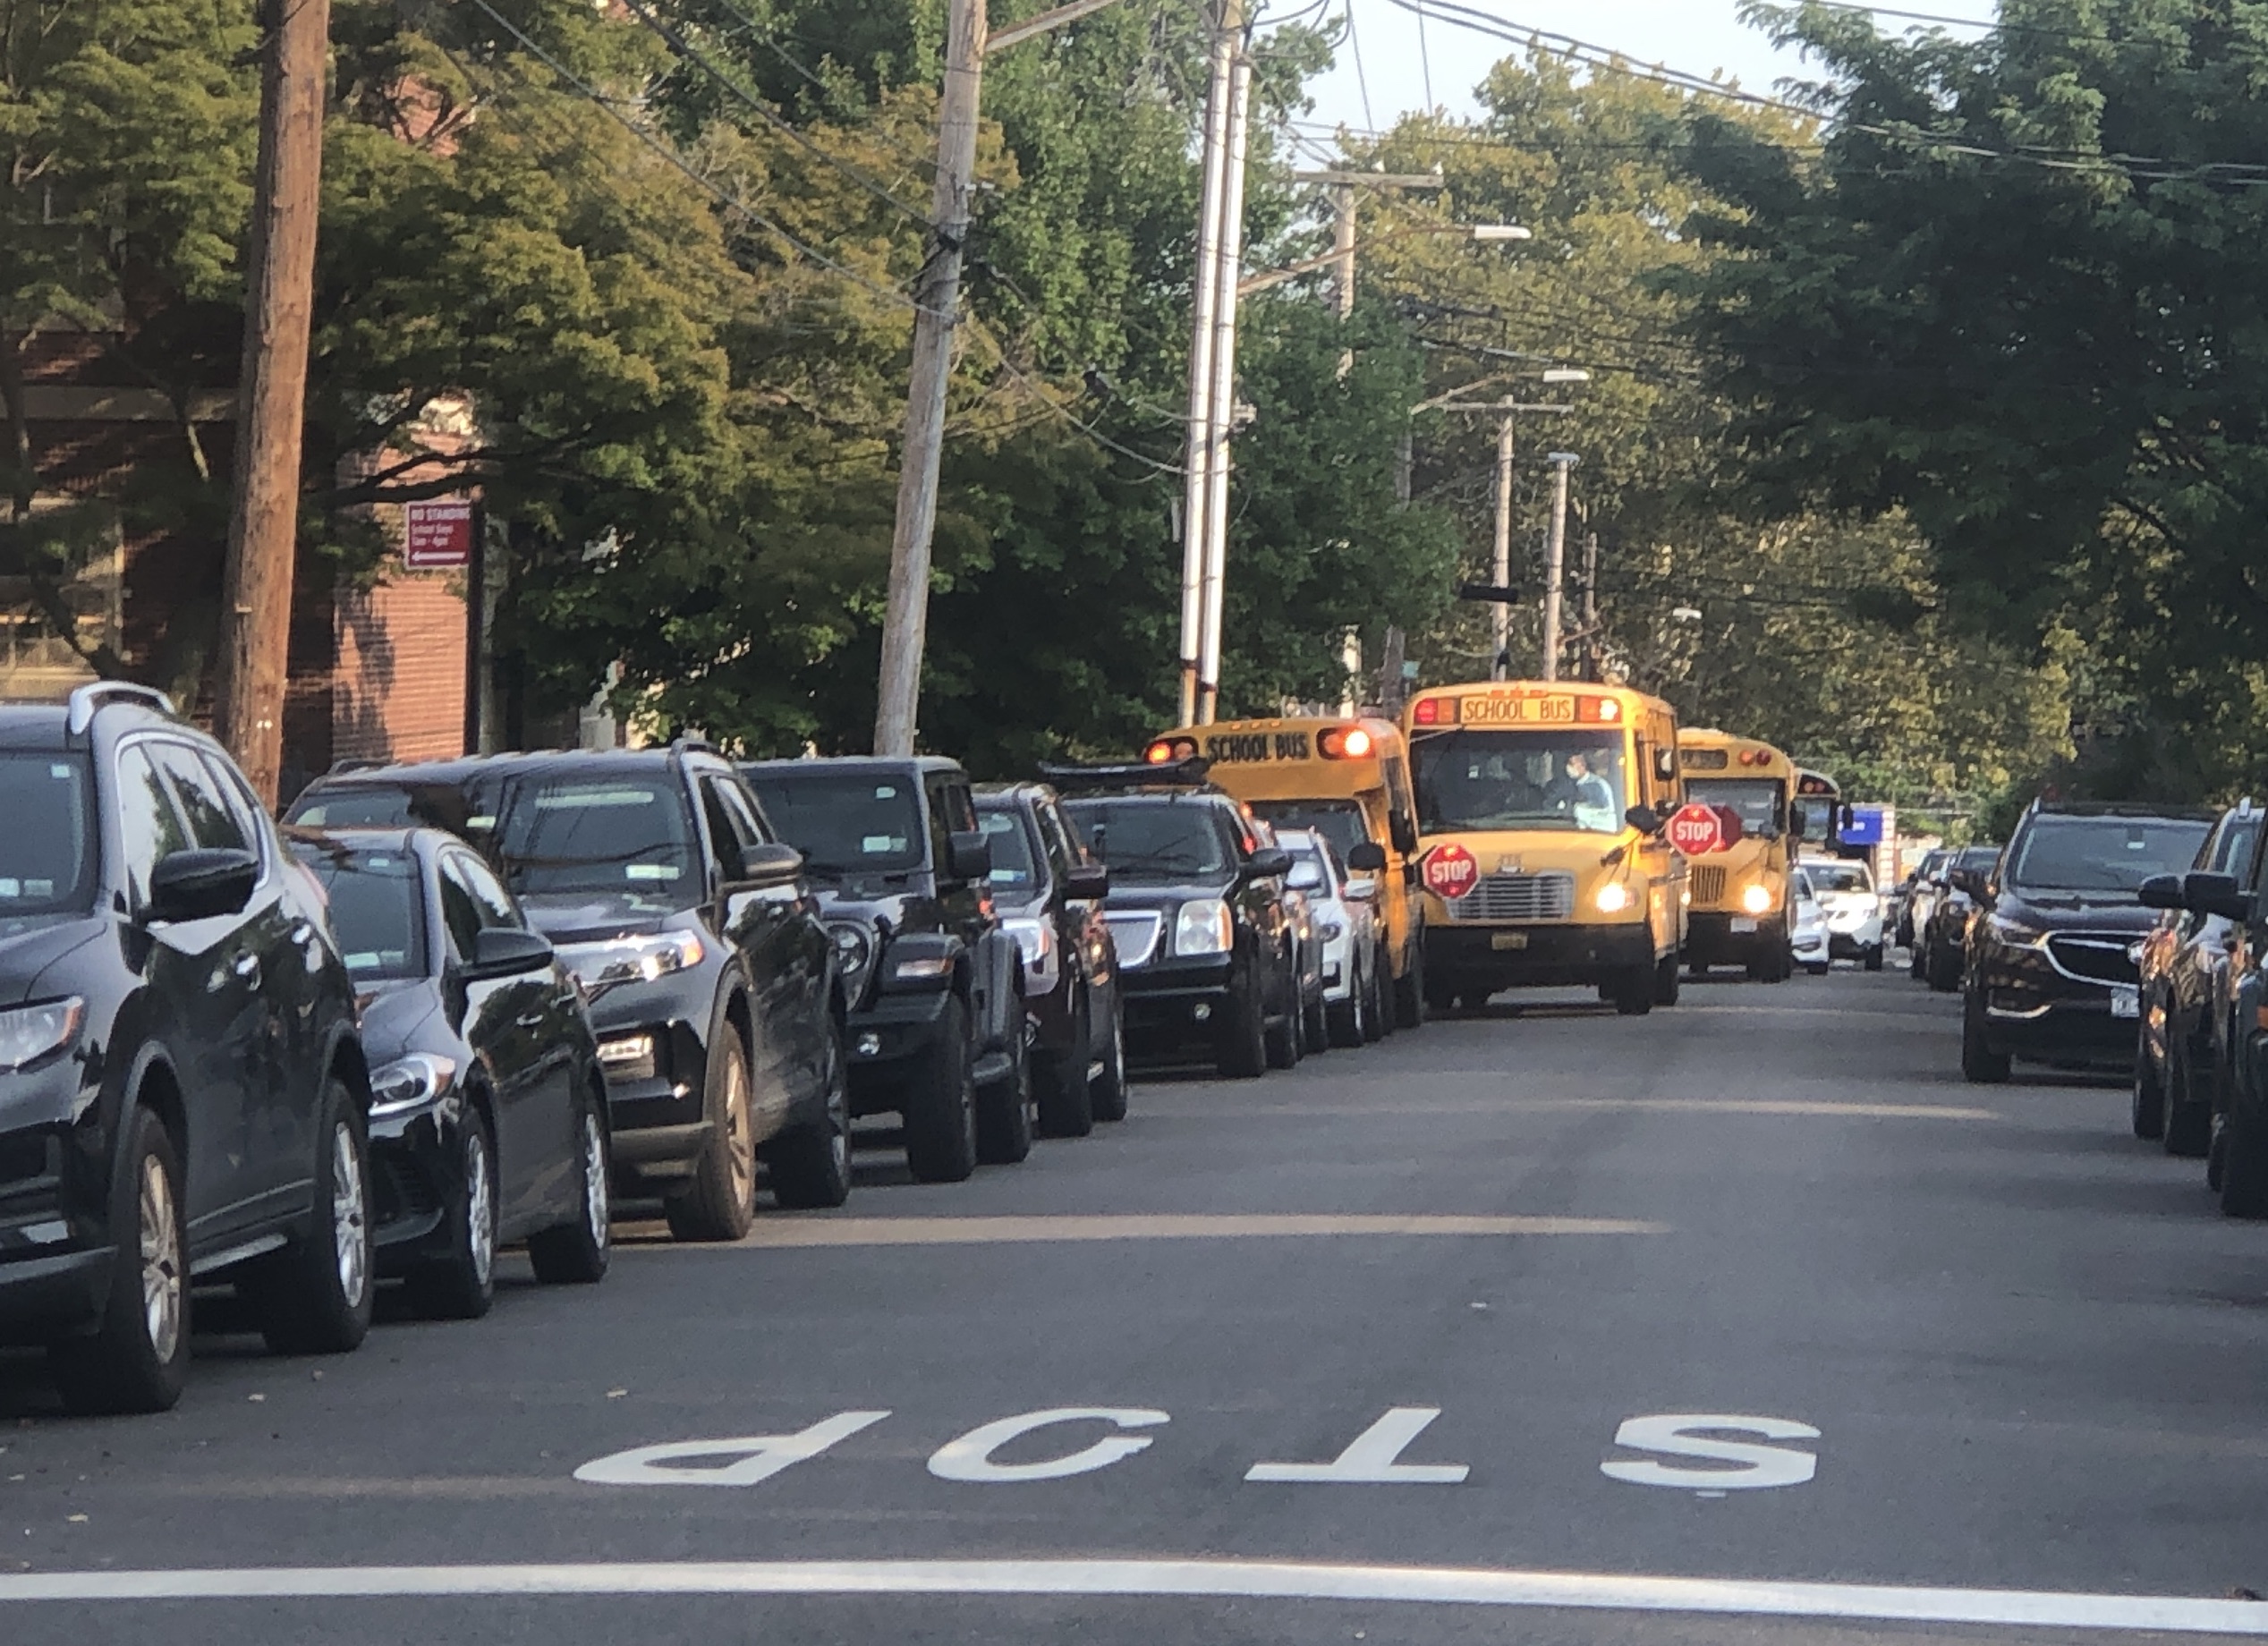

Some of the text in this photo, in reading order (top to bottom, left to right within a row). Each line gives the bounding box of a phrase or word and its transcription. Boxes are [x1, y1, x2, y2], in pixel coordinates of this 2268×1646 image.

[1464, 699, 1571, 721] SCHOOL BUS
[1205, 732, 1310, 766] SCHOOL BUS
[1675, 819, 1715, 842] STOP
[1431, 858, 1473, 884] STOP
[573, 1405, 1822, 1489] STOP
